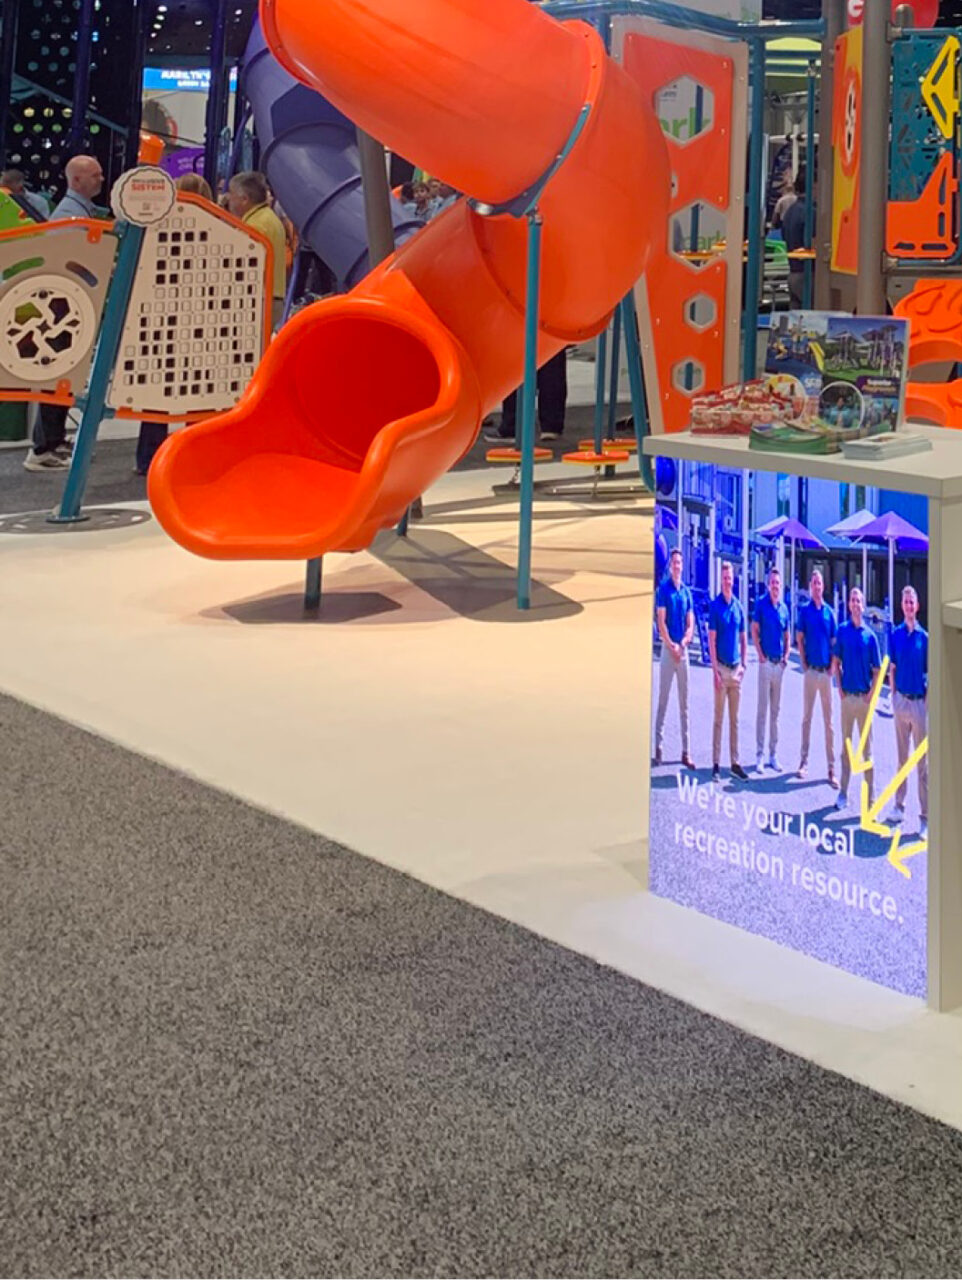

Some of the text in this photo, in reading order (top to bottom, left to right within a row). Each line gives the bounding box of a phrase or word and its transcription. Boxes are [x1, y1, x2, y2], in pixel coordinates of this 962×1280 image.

[677, 772, 855, 858] We're your local
[674, 822, 904, 924] recreation resource.
